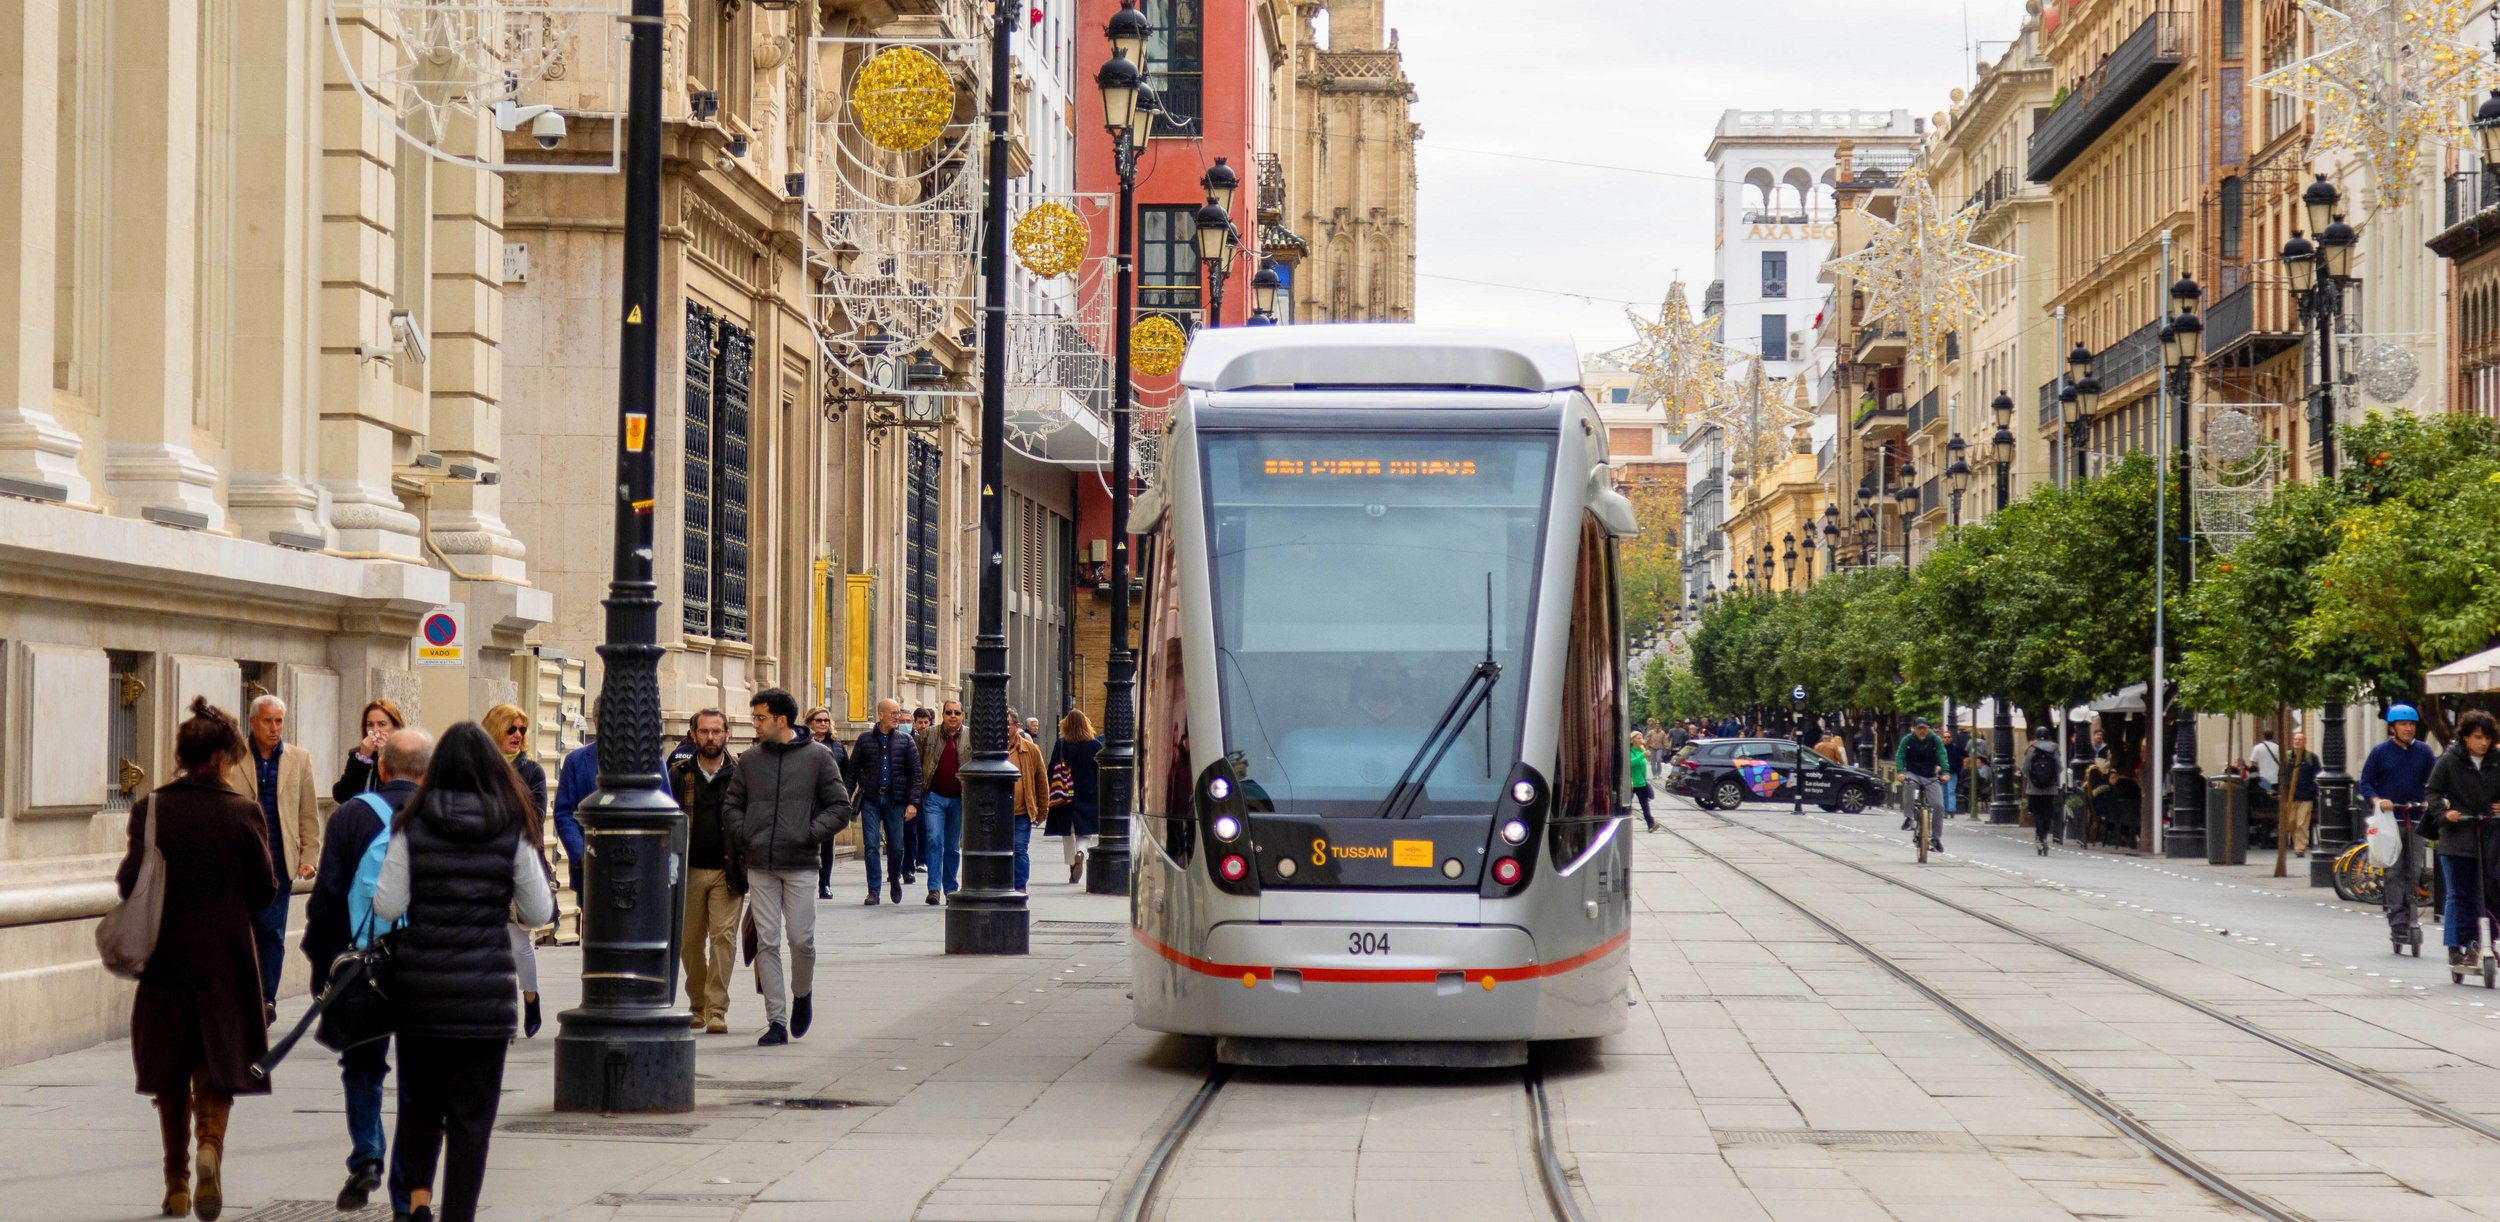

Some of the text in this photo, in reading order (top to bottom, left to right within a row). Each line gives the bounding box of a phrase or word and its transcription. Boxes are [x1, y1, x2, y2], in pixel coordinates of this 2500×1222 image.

[1747, 223, 1793, 240] AXA
[1331, 846, 1388, 859] TUSSAM
[1348, 932, 1390, 956] 304
